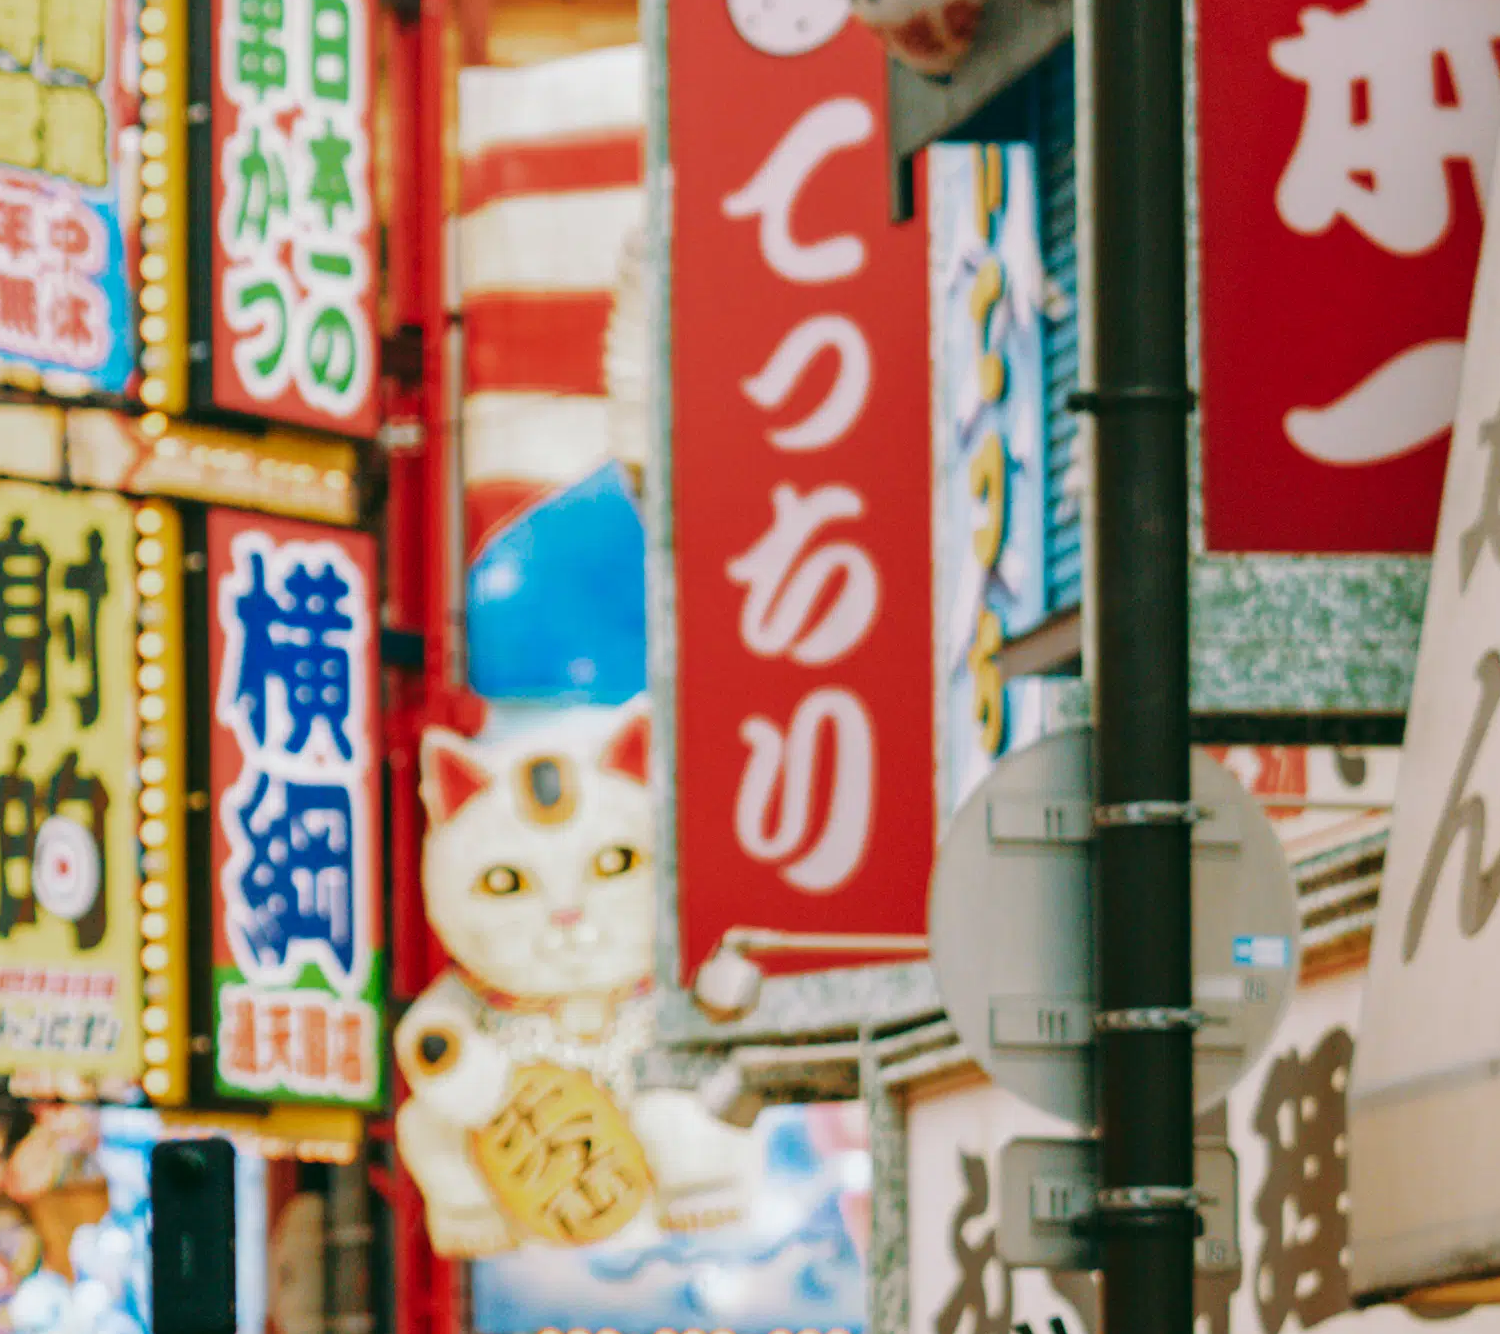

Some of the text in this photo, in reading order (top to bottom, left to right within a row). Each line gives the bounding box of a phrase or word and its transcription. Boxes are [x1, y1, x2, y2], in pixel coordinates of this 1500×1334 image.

[232, 550, 356, 976] 横綱
[722, 96, 883, 894] てっちり
